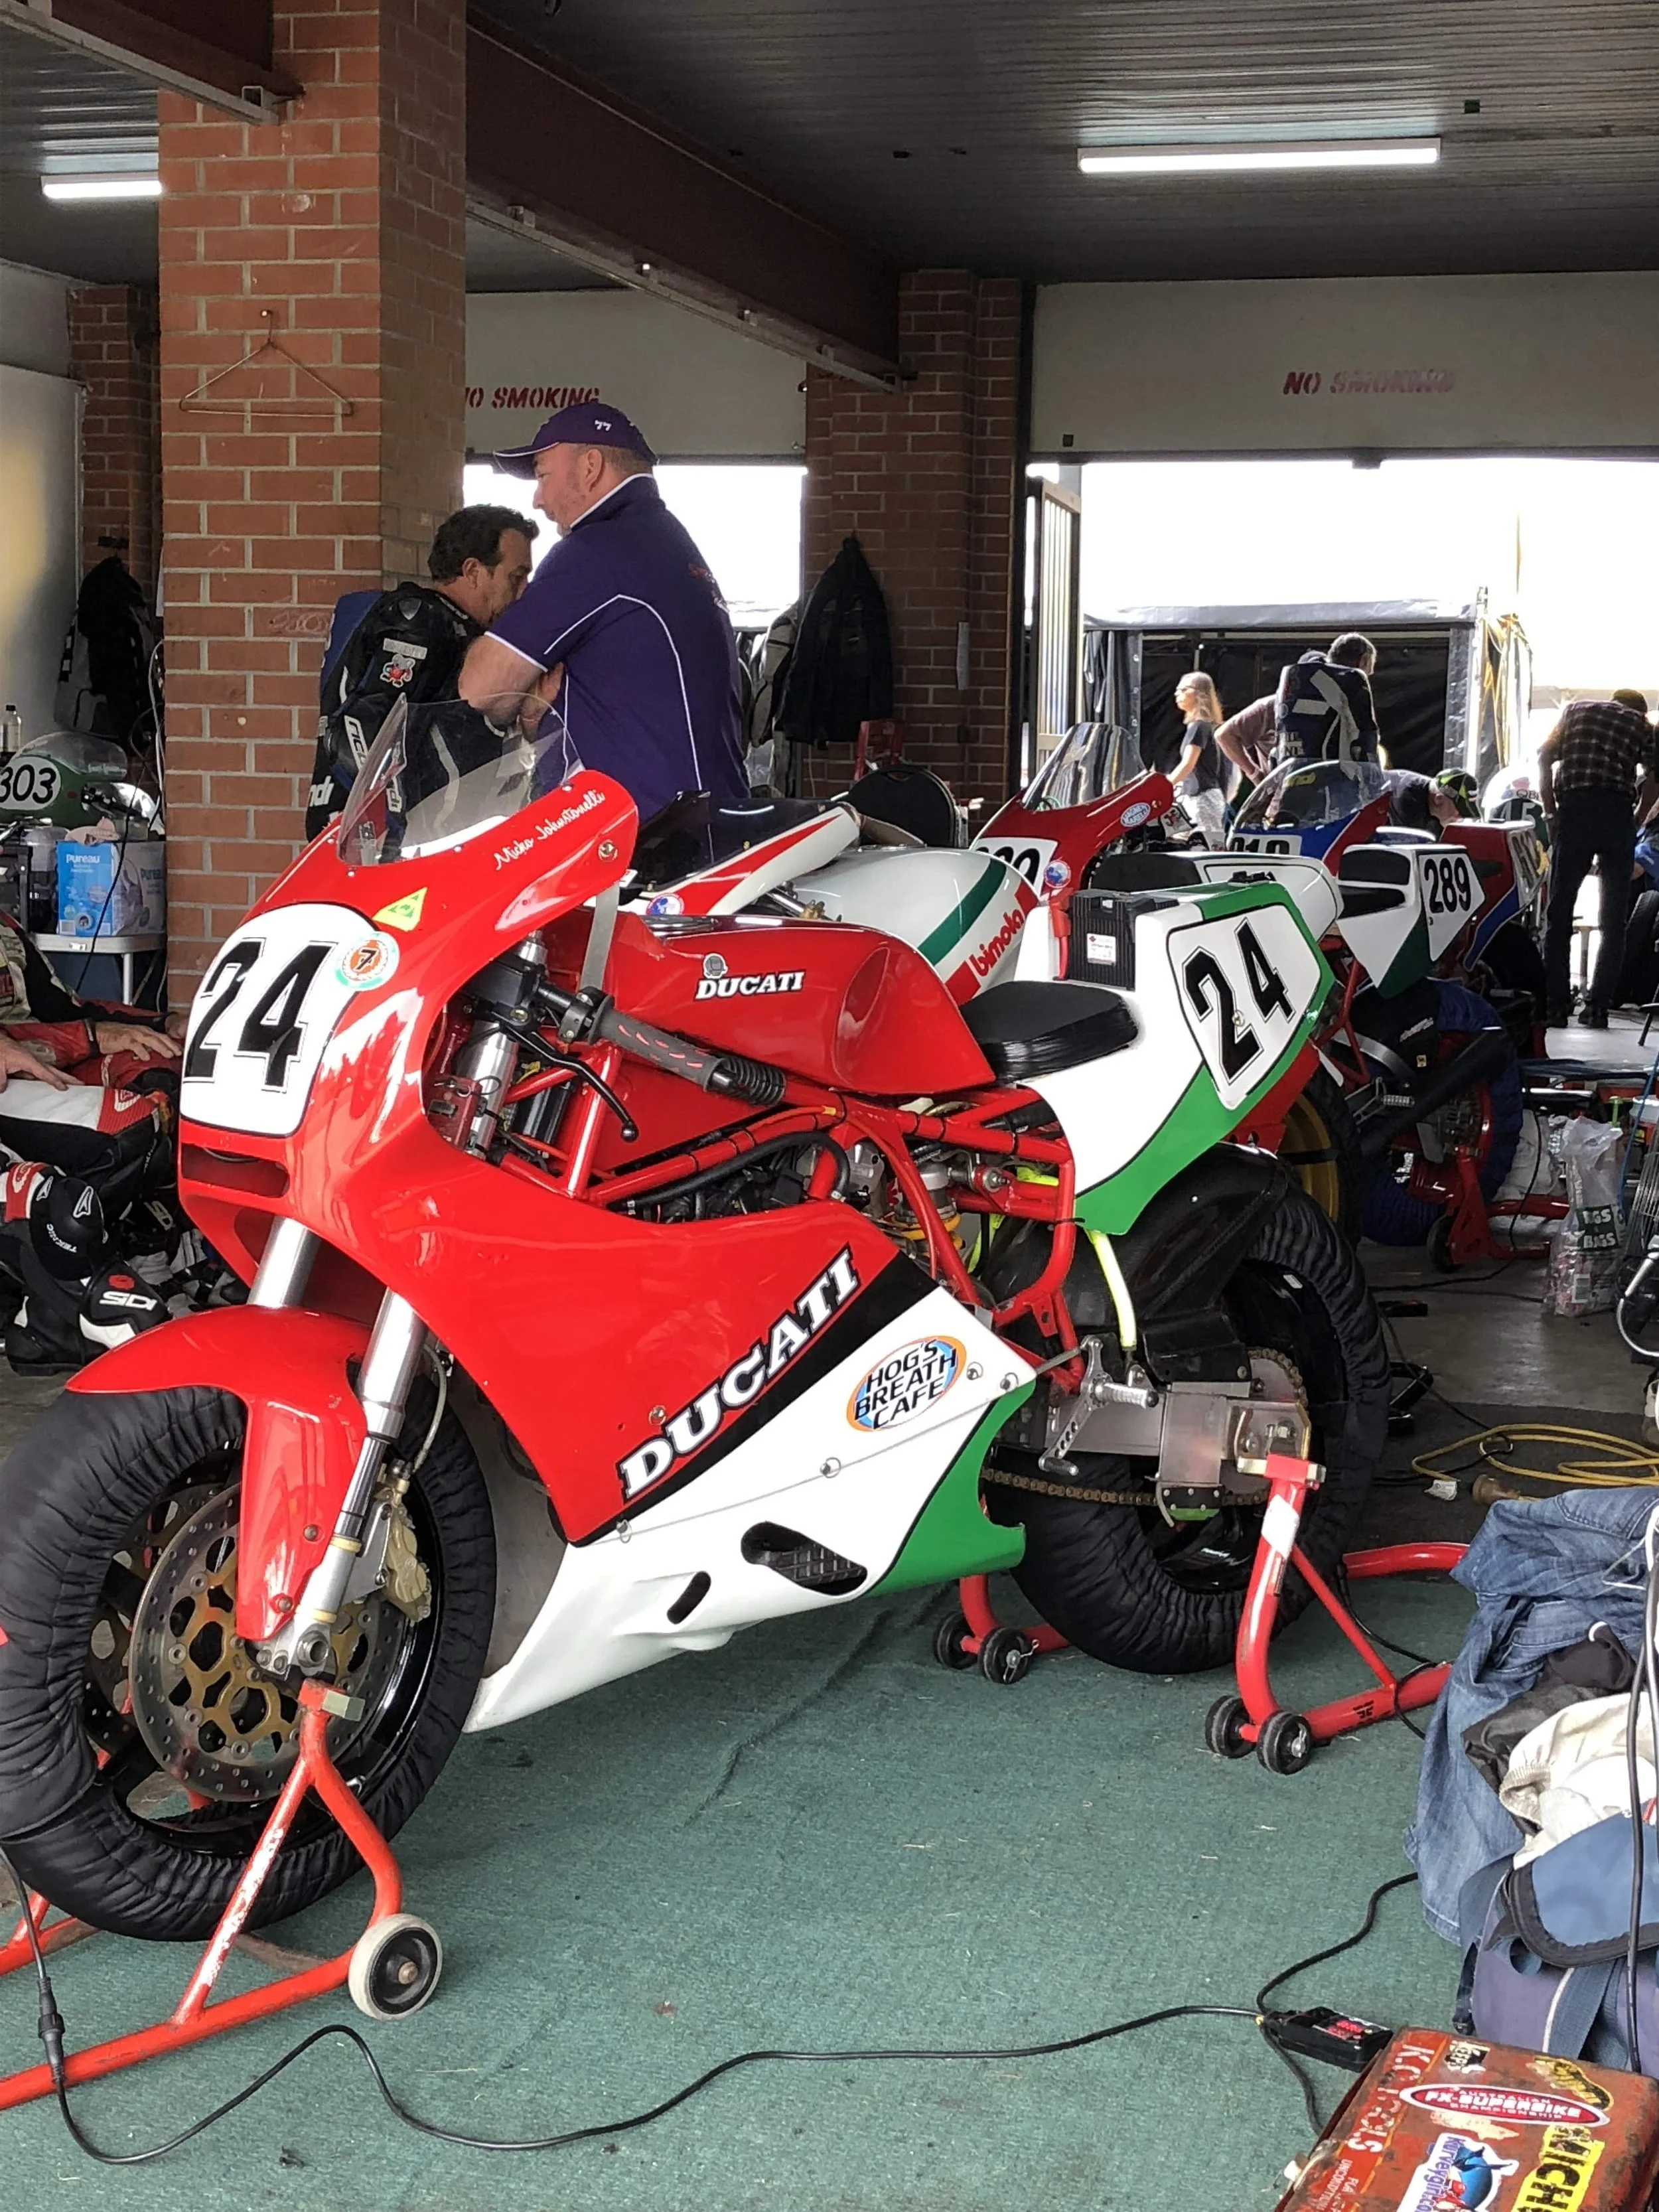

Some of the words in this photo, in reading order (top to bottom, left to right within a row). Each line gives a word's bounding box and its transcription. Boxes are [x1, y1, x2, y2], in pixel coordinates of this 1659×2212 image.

[491, 387, 600, 409] SMOKING
[1283, 372, 1321, 394] NO
[0, 763, 56, 804] 303
[66, 853, 101, 864] pureau
[1424, 857, 1472, 914] 289
[968, 908, 1025, 977] bimota
[694, 971, 805, 1000] DUCATI
[1181, 916, 1297, 1086] 24
[182, 937, 338, 1094] 24
[619, 1248, 861, 1501] DUCATI
[854, 1348, 957, 1421] BREATH
[865, 1338, 939, 1394] HOG'S
[873, 1369, 945, 1430] CAFE
